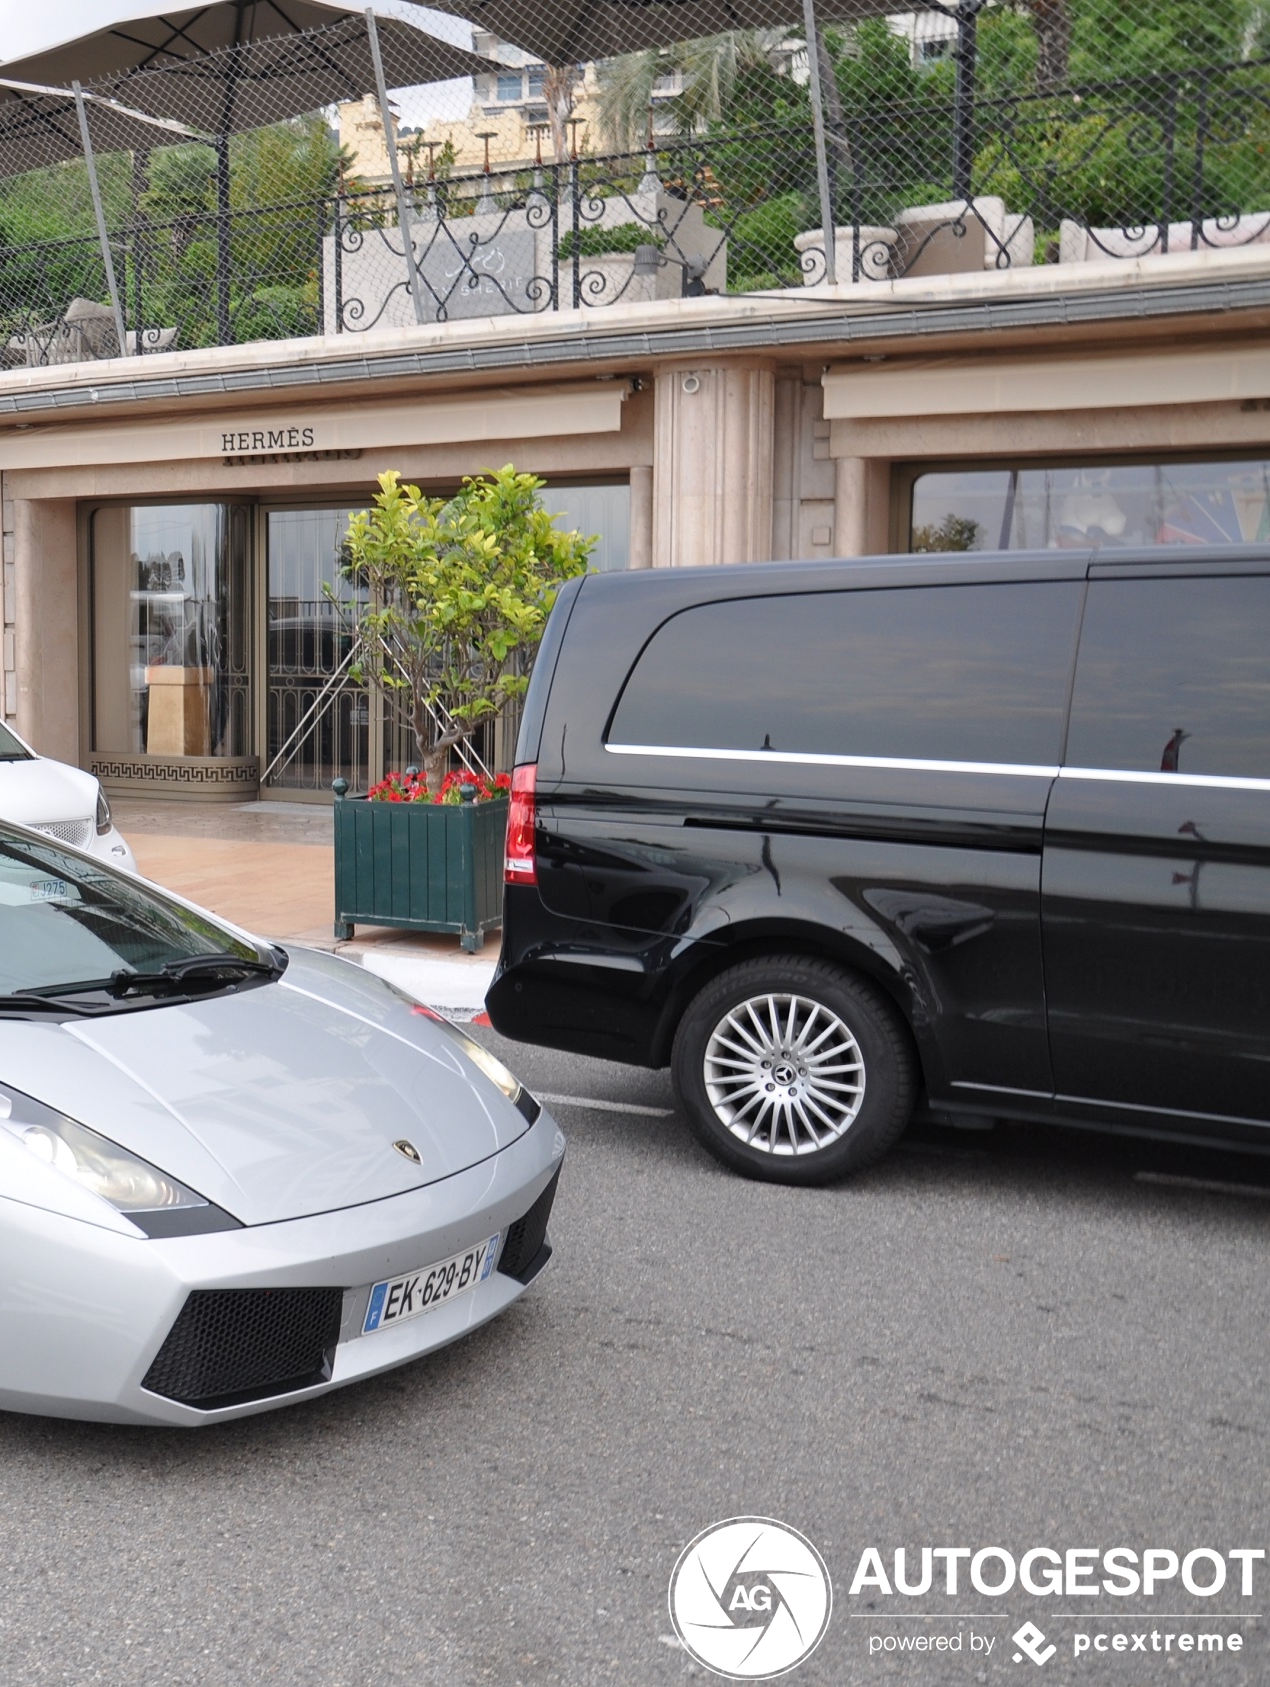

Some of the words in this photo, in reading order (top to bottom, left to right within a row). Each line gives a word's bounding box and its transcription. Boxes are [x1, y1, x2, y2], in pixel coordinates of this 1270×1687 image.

[221, 427, 315, 452] HERMÈS
[41, 881, 66, 897] J275
[369, 1310, 378, 1327] F
[383, 1245, 488, 1322] EK-629-BY
